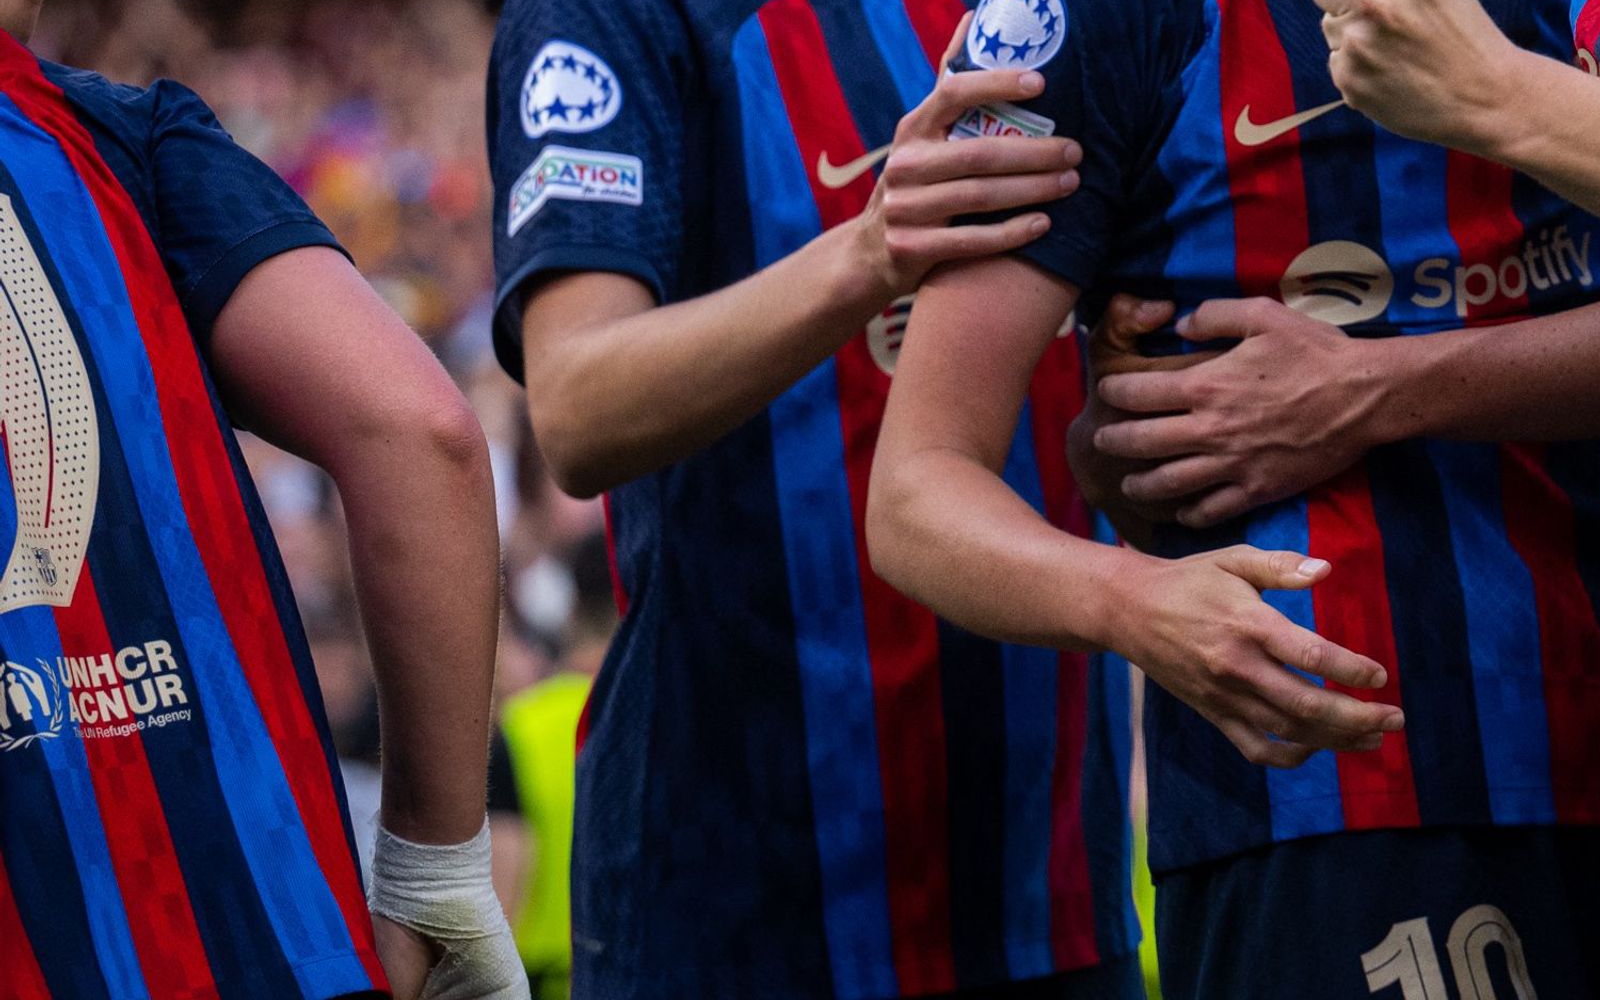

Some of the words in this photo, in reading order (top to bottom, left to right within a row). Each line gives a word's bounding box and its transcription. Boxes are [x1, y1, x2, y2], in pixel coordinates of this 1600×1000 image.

[1411, 225, 1593, 317] Spotify
[57, 639, 178, 688] UNHCR
[68, 674, 187, 725] ACNUR
[96, 720, 145, 738] Refugee
[148, 709, 191, 727] Agency
